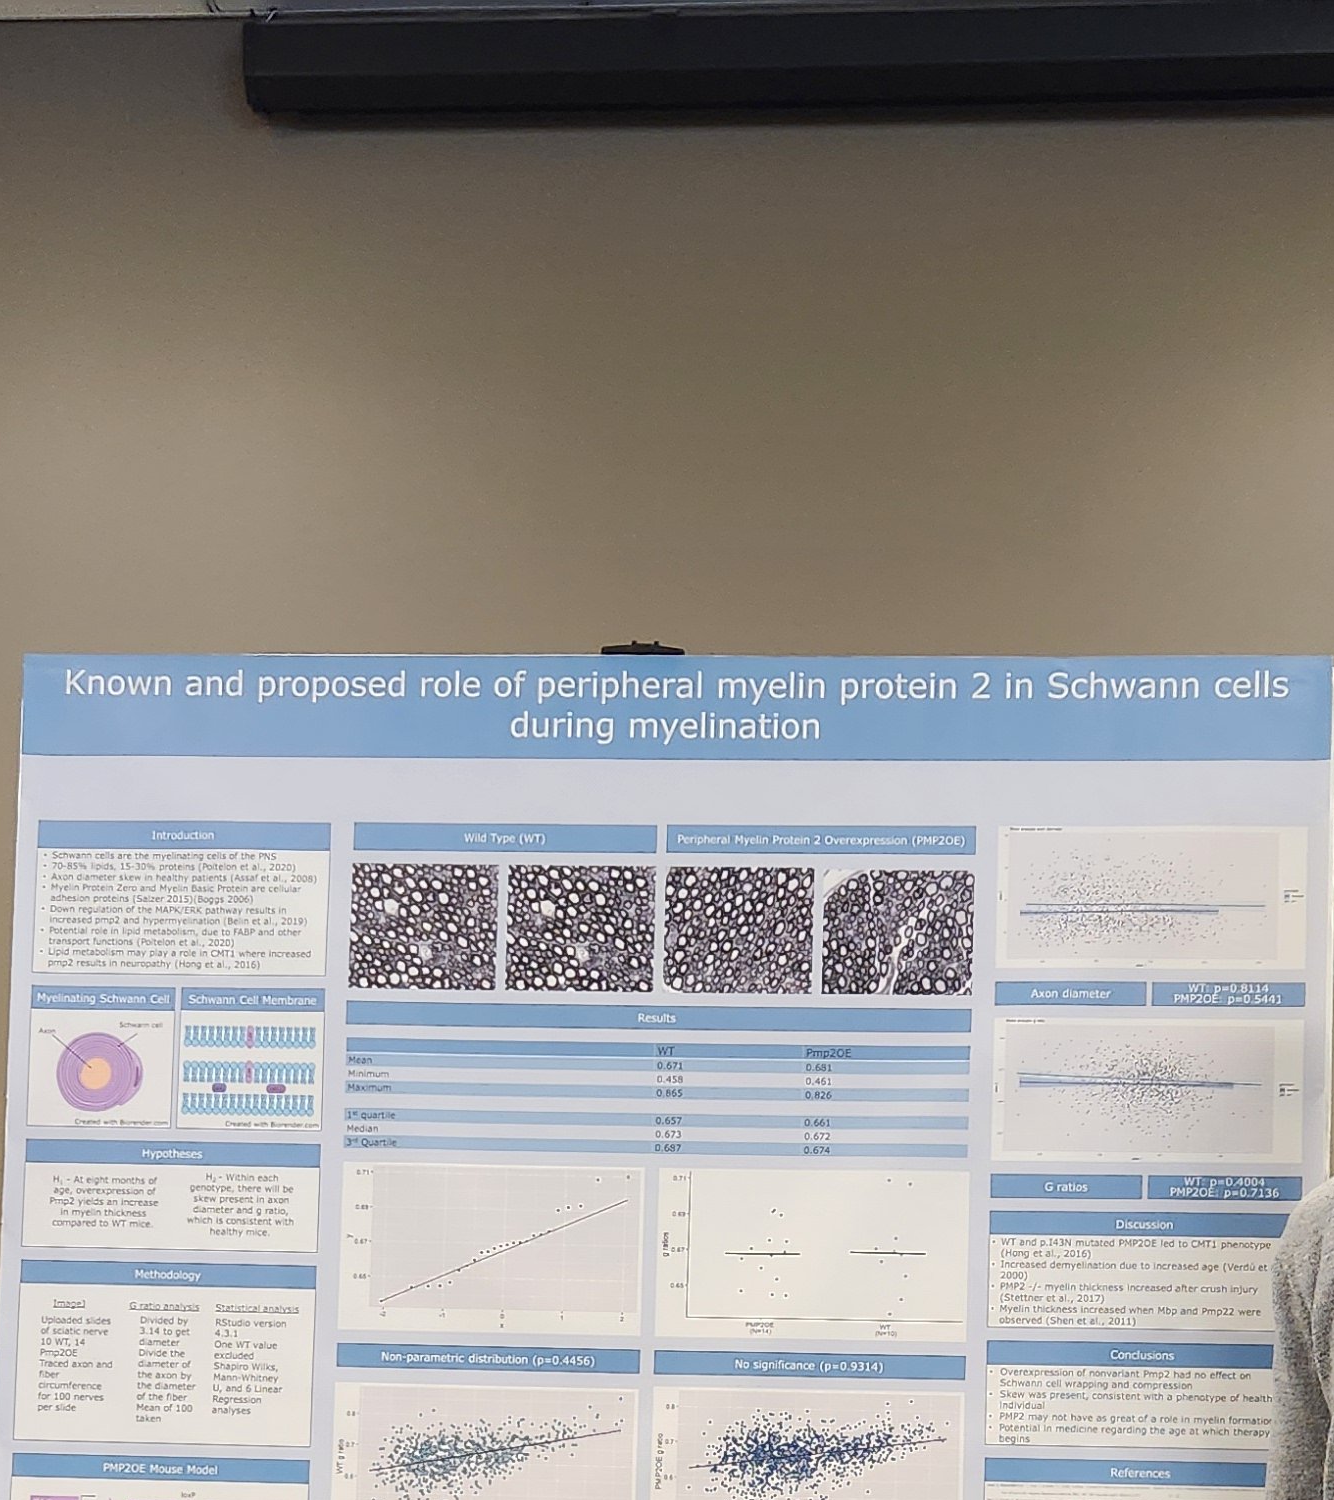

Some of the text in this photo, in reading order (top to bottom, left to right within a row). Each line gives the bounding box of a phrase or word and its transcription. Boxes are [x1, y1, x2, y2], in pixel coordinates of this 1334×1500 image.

[65, 669, 1288, 705] Known and proposed role of peripheral myelin protein 2 in Schwann cells
[510, 710, 819, 743] during myelination
[151, 830, 214, 840] Introduction
[464, 832, 545, 845] Wild Type (WT)
[677, 834, 965, 848] Peripheral Myelin Protein 2 Overexpression (PMP2OE)
[1030, 988, 1111, 998] Axon diameter
[1188, 983, 1268, 995] WT: p=0.8114
[36, 992, 169, 1005] Myelinating Schwann Cell
[188, 994, 316, 1005] Schwann Cell Membrane
[1174, 994, 1281, 1005] PMP2OE: p=0.5441
[637, 1012, 676, 1023] Results
[657, 1046, 675, 1057] WT
[805, 1048, 852, 1060] Pmp2OE
[348, 1056, 372, 1064] Mean
[347, 1069, 389, 1078] Minimum
[347, 1083, 391, 1092] Maximum
[360, 1111, 395, 1121] quartile
[346, 1124, 379, 1133] Median
[361, 1138, 397, 1148] Quartile
[141, 1147, 202, 1160] Hypotheses
[1044, 1181, 1088, 1192] G ratios
[1183, 1176, 1264, 1188] WT: p=0.4004
[53, 1186, 156, 1196] age, overexpression of
[1170, 1187, 1279, 1199] PMP2OE: p=0.7136
[49, 1196, 74, 1206] Pmp2
[77, 1197, 104, 1207] yields
[120, 1198, 159, 1206] increase
[60, 1207, 146, 1217] in myelin thickness
[51, 1218, 153, 1228] compared to WT mice.
[1115, 1219, 1173, 1229] Discussion
[134, 1269, 201, 1281] Methodology
[381, 1351, 595, 1367] Non-parametric distribution (p=0.4456)
[1110, 1349, 1174, 1360] Conclusions
[734, 1358, 883, 1374] No significance (p=0.9314)
[999, 1368, 1073, 1379] Overexpression
[1076, 1368, 1086, 1377] of
[1089, 1369, 1139, 1378] nonvariant
[1143, 1369, 1169, 1380] Pmp2
[1173, 1370, 1191, 1379] had
[1209, 1370, 1236, 1380] effect
[1239, 1372, 1251, 1380] on
[999, 1378, 1192, 1391] Schwann cell wrapping and compression
[103, 1462, 217, 1475] PMP2OE Mouse Model
[1110, 1467, 1170, 1478] References
